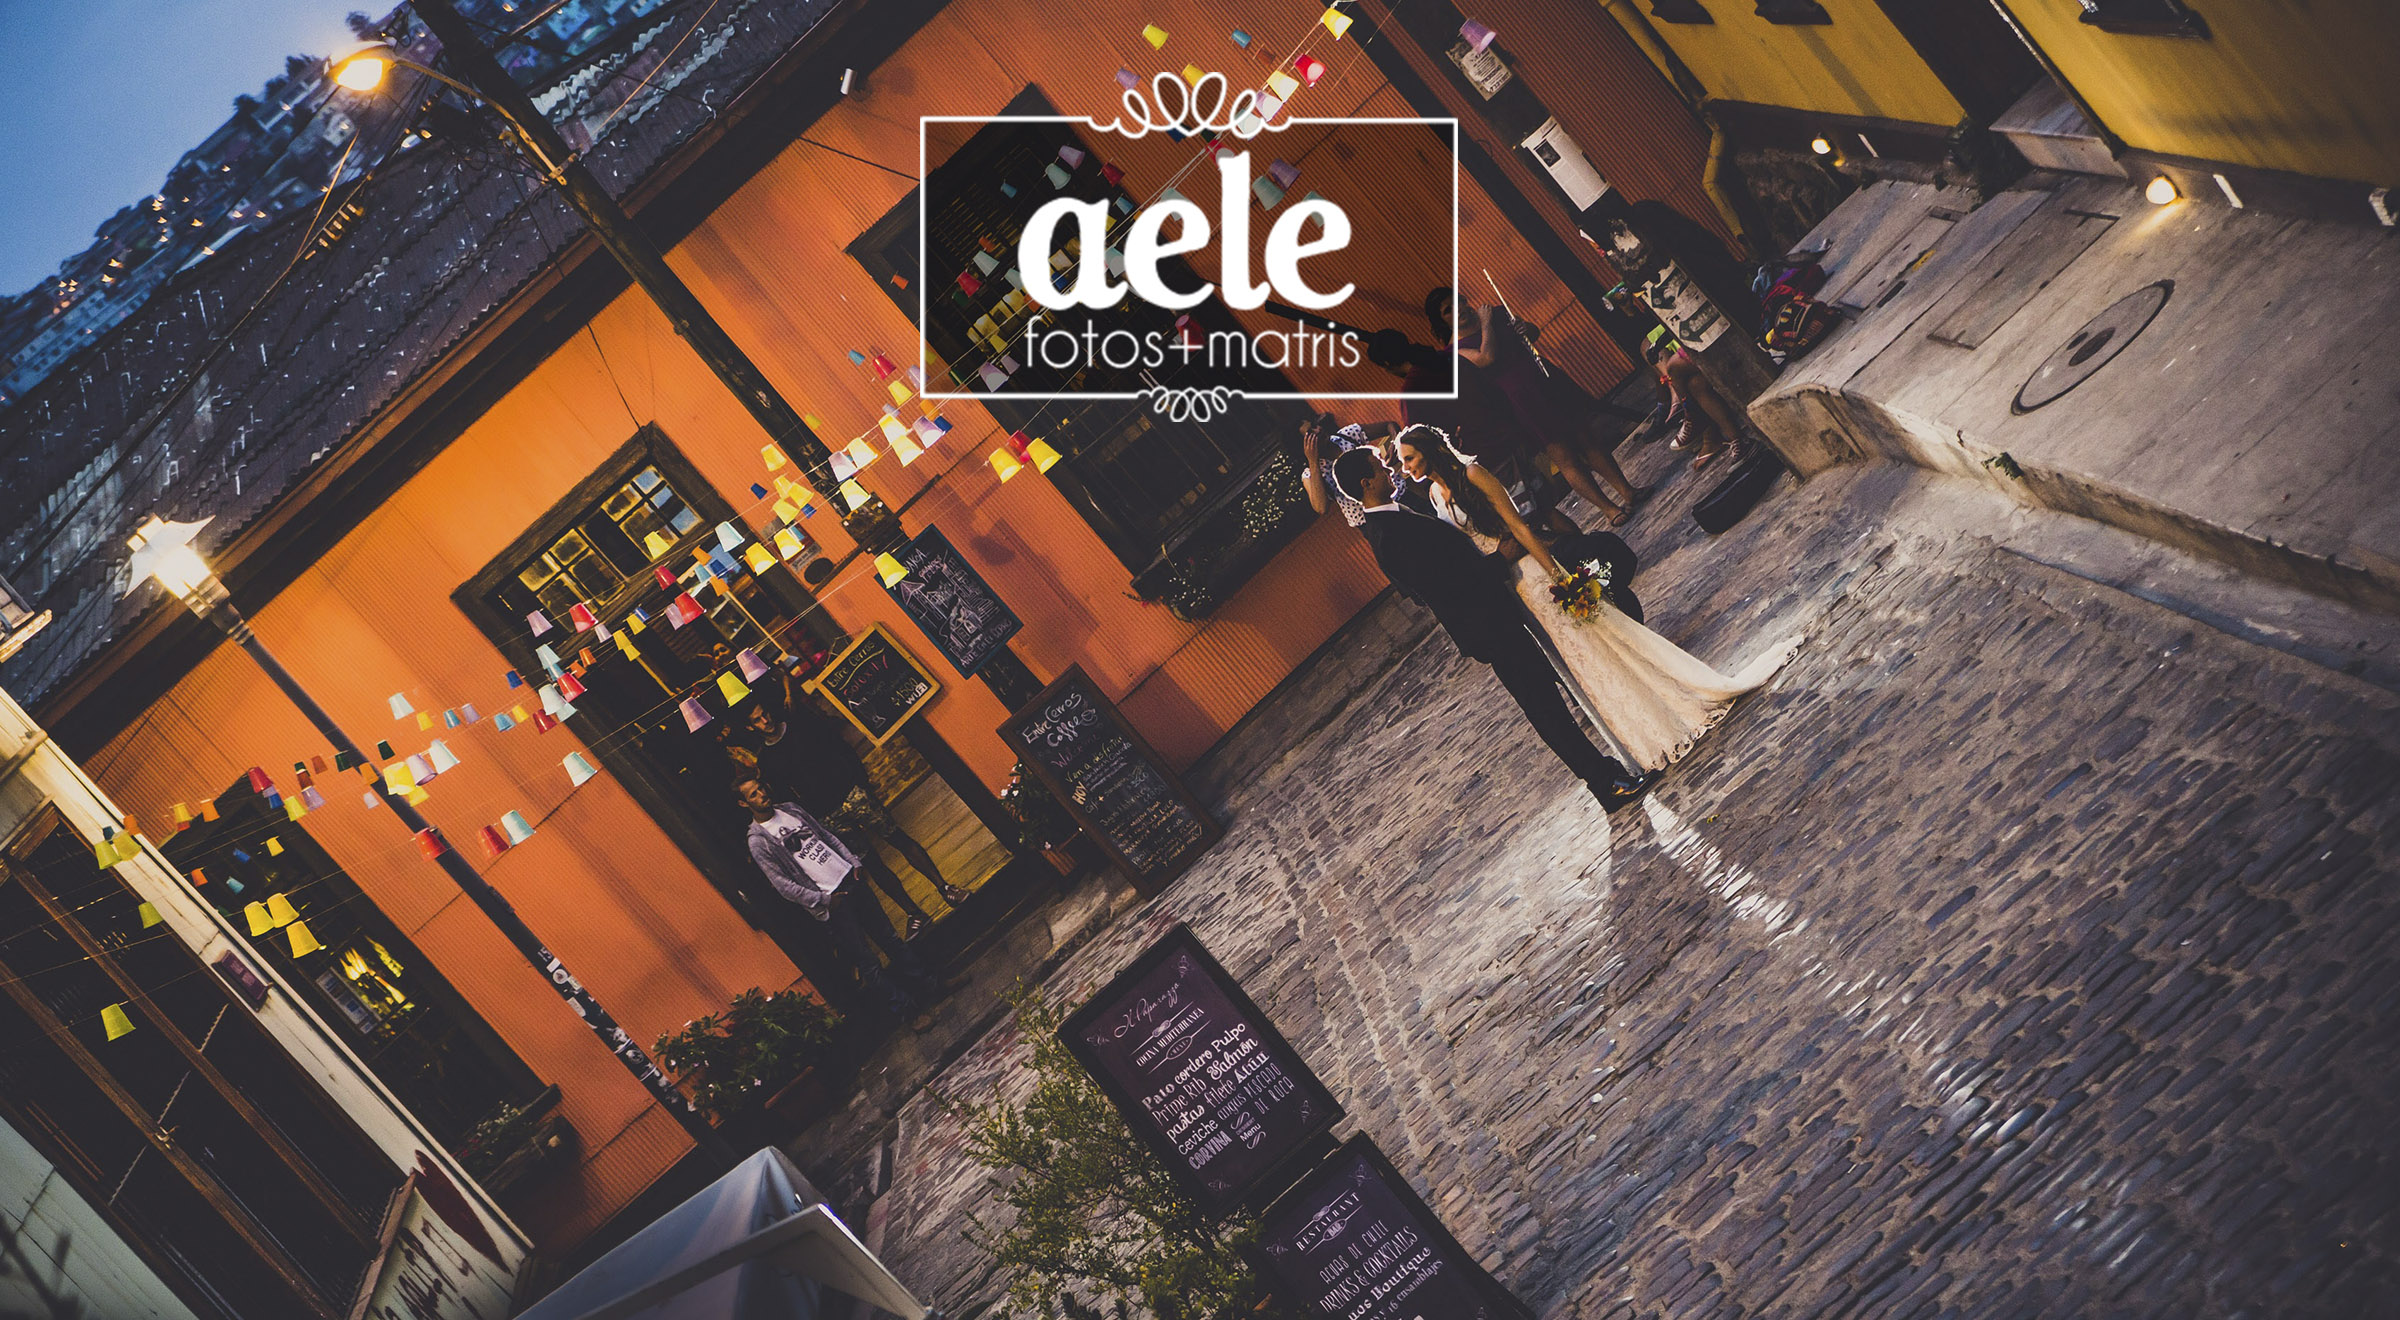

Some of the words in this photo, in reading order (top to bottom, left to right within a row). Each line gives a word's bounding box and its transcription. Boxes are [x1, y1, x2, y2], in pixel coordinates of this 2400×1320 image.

[847, 642, 874, 667] Cerros
[1022, 721, 1050, 744] Entre
[1045, 693, 1082, 723] Cerros
[1047, 716, 1080, 747] Coffee
[1071, 780, 1086, 805] HOY
[1135, 1046, 1159, 1066] COCINA
[1156, 1007, 1204, 1047] MEDITERRANEA
[1141, 1083, 1175, 1110] Pato
[1174, 1049, 1212, 1084] cordero
[1210, 1022, 1245, 1052] Pulpo
[1151, 1094, 1188, 1125] Prime
[1182, 1076, 1207, 1099] Rib
[1166, 1104, 1205, 1144] pastas
[1203, 1079, 1236, 1107] filete
[1175, 1119, 1218, 1155] ceviche
[1216, 1093, 1246, 1120] angus
[1243, 1062, 1281, 1098] PESCADO
[1188, 1130, 1232, 1169] CORVINA
[1253, 1097, 1269, 1114] DE
[1267, 1075, 1294, 1102] ROCA
[1239, 1122, 1261, 1141] Menu
[1296, 1192, 1359, 1250] RESTAURANT
[1326, 1222, 1343, 1236] BAR
[1361, 1219, 1388, 1247] CHILE
[1319, 1276, 1360, 1312] DRINKS
[1352, 1269, 1370, 1286] &
[1362, 1225, 1417, 1278] COCKTAILS
[1370, 1247, 1430, 1300] Boutique
[1396, 1259, 1443, 1301] ensamblajes
